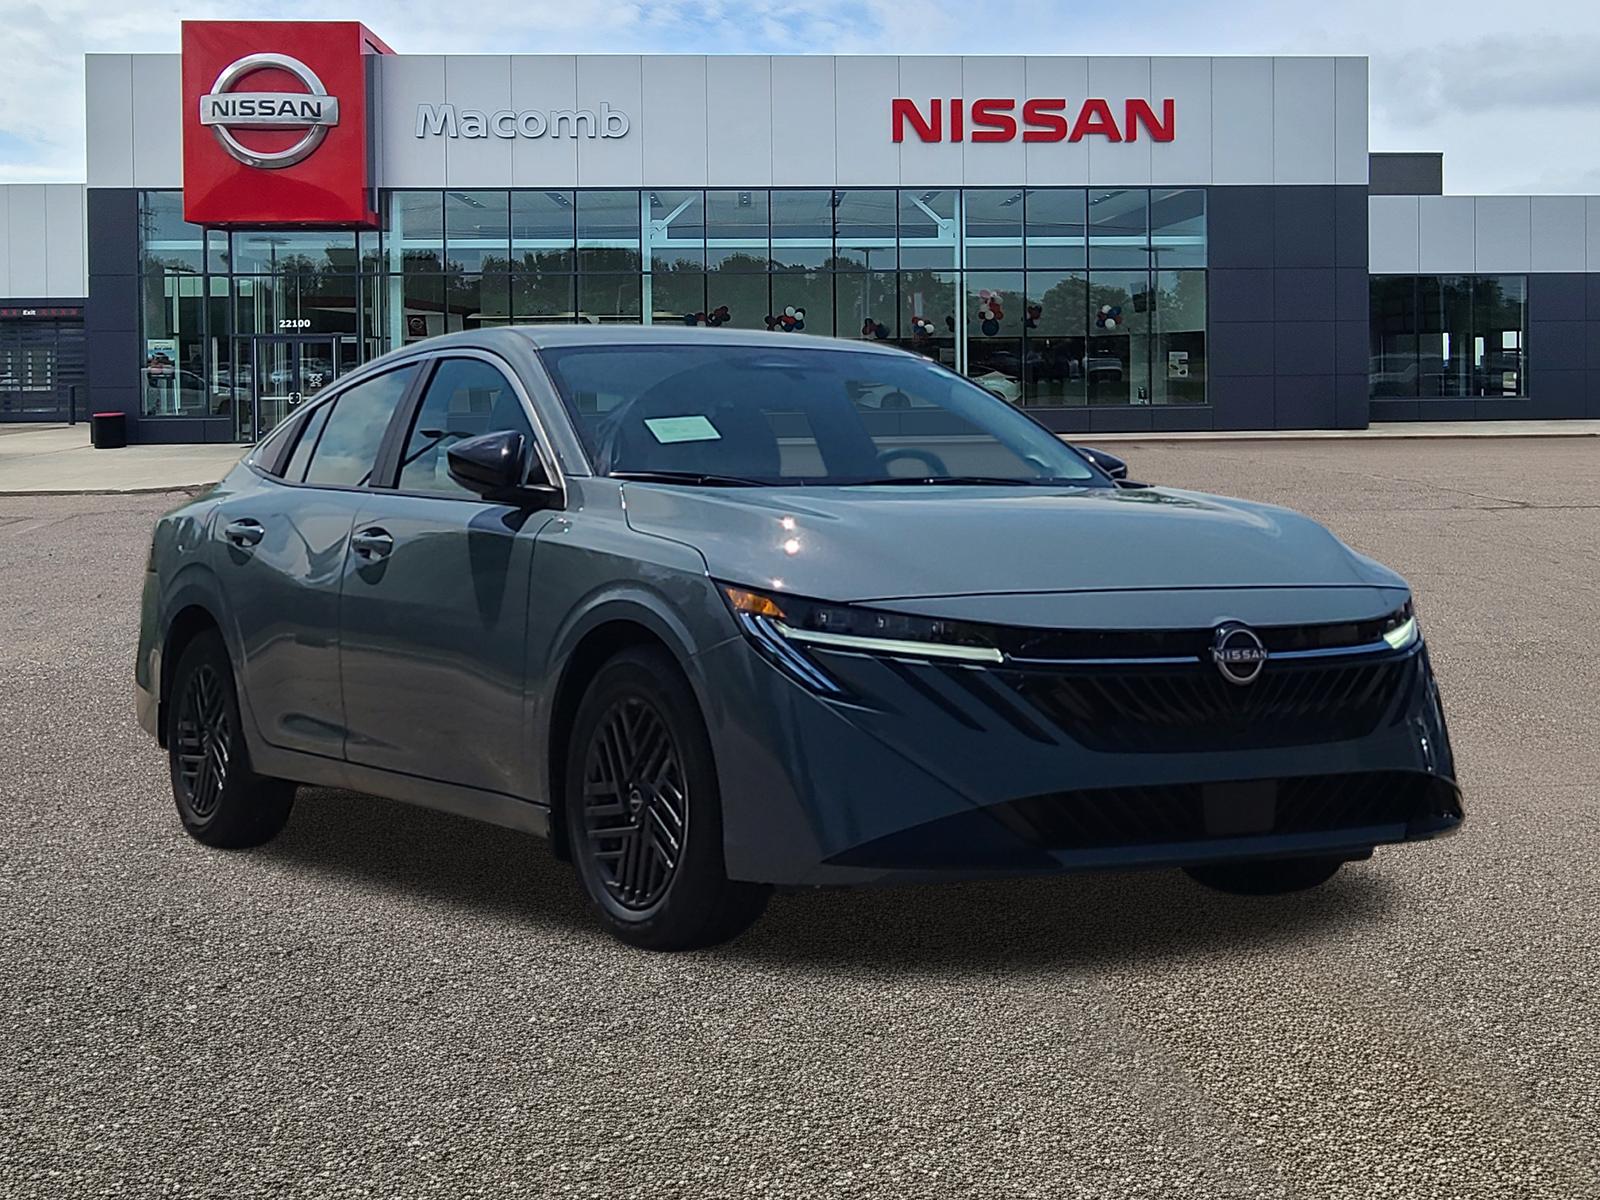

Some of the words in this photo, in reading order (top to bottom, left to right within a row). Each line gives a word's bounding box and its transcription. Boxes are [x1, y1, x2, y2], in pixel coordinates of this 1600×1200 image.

[211, 100, 322, 117] NISSAN
[415, 102, 630, 138] Macomb
[892, 98, 1175, 143] NISSAN
[279, 319, 311, 328] 22100
[1213, 649, 1268, 662] NISSAN
